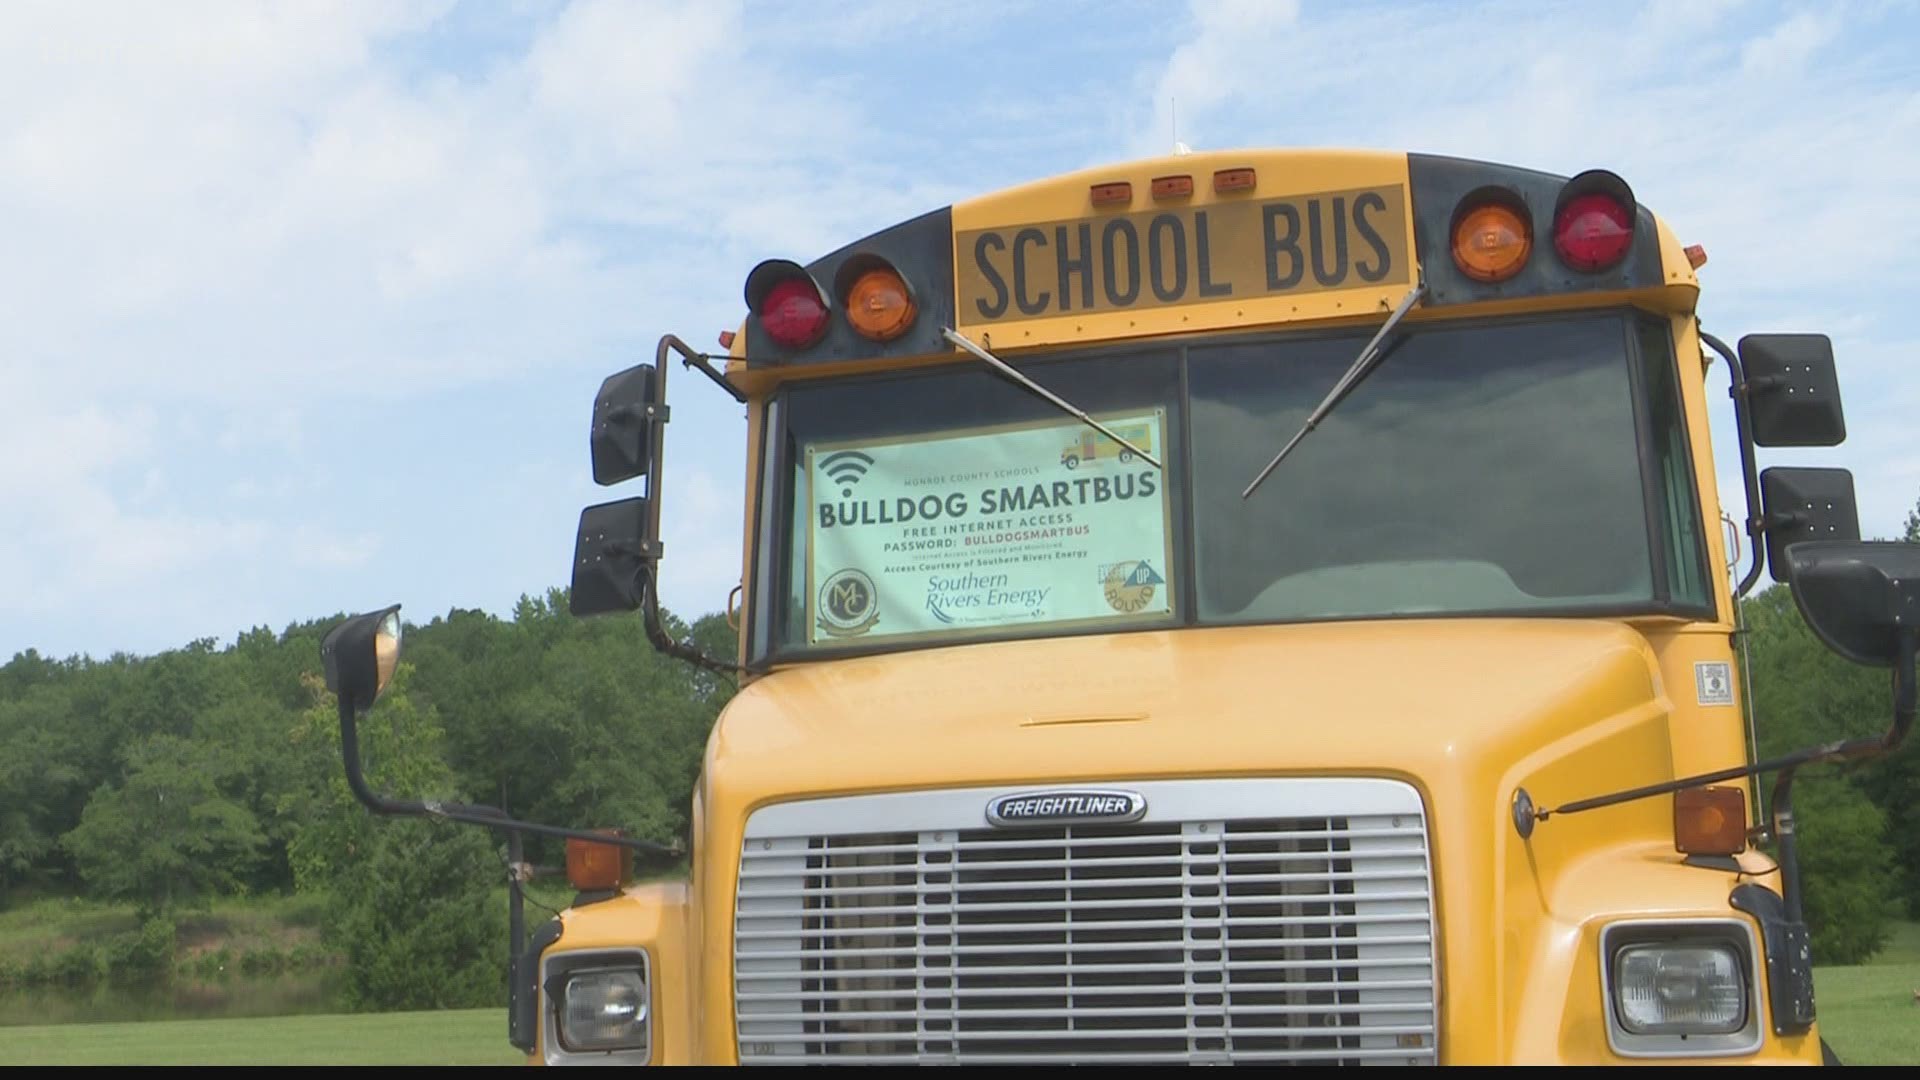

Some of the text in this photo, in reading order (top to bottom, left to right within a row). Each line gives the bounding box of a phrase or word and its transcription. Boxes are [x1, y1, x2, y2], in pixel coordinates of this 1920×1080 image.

[974, 191, 1392, 320] SCHOOL BUS
[904, 466, 1040, 487] MONROE COUNTY SCHOOLS
[819, 471, 1156, 528] BULLDOG SMARTBUS
[903, 513, 1073, 538] FREE INTERNET ACCESS
[884, 524, 1090, 552] PASSWORD: BULLDOGSMARTBUS
[884, 549, 1088, 573] Access Courtesy of Southern Rivers Energy
[927, 571, 1008, 593] Southern
[1136, 567, 1150, 584] UP
[926, 586, 1051, 609] Rivers Energy
[1106, 586, 1153, 612] ROUND
[1003, 798, 1127, 817] FREIGHTLINER
